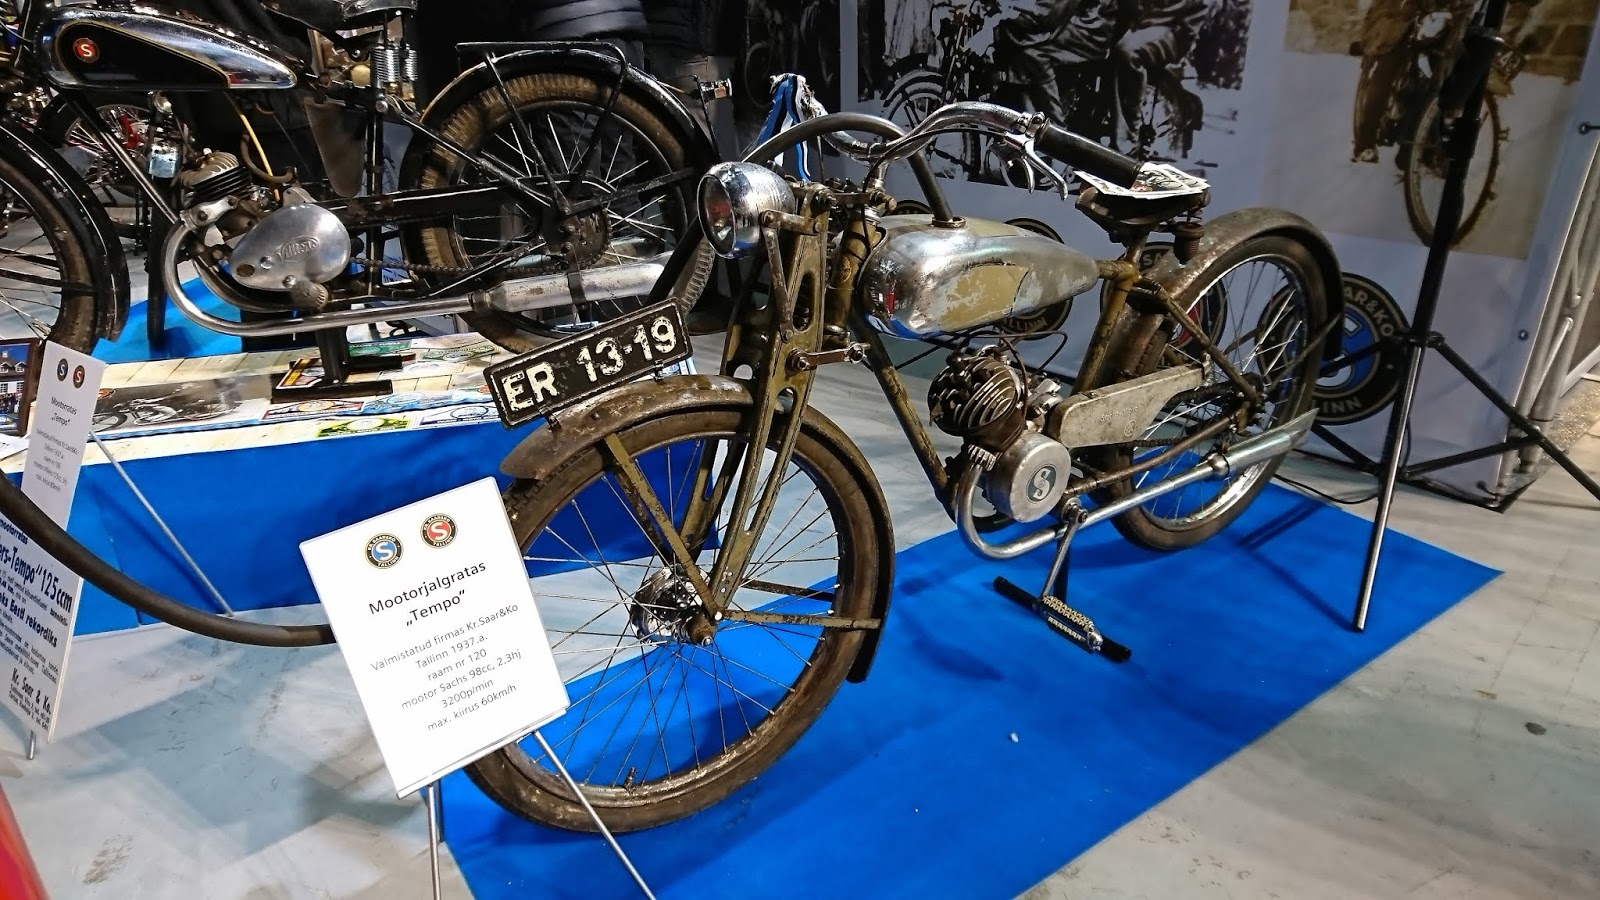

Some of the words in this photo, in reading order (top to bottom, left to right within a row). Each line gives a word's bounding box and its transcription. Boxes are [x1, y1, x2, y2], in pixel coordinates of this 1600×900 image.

[80, 44, 92, 57] S
[501, 361, 559, 412] ER
[576, 316, 677, 382] 13-19
[369, 562, 486, 614] Mootorjalgratas
[10, 599, 25, 621] Eesti
[26, 614, 58, 648] rekordiks
[370, 639, 432, 671] Valmistatud
[434, 627, 465, 645] firmas
[466, 604, 519, 631] Kr.Saar&Ko
[415, 650, 449, 669] Tallinn
[451, 635, 488, 654] 1937.a.
[427, 665, 453, 681] raam
[455, 659, 466, 670] nr
[468, 648, 487, 663] 120
[401, 688, 437, 710] mootor
[439, 675, 468, 692] Sachs
[427, 717, 452, 732] max.
[453, 701, 480, 719] kiirus
[481, 684, 517, 706] 60km/h
[441, 679, 494, 708] 3200p/min
